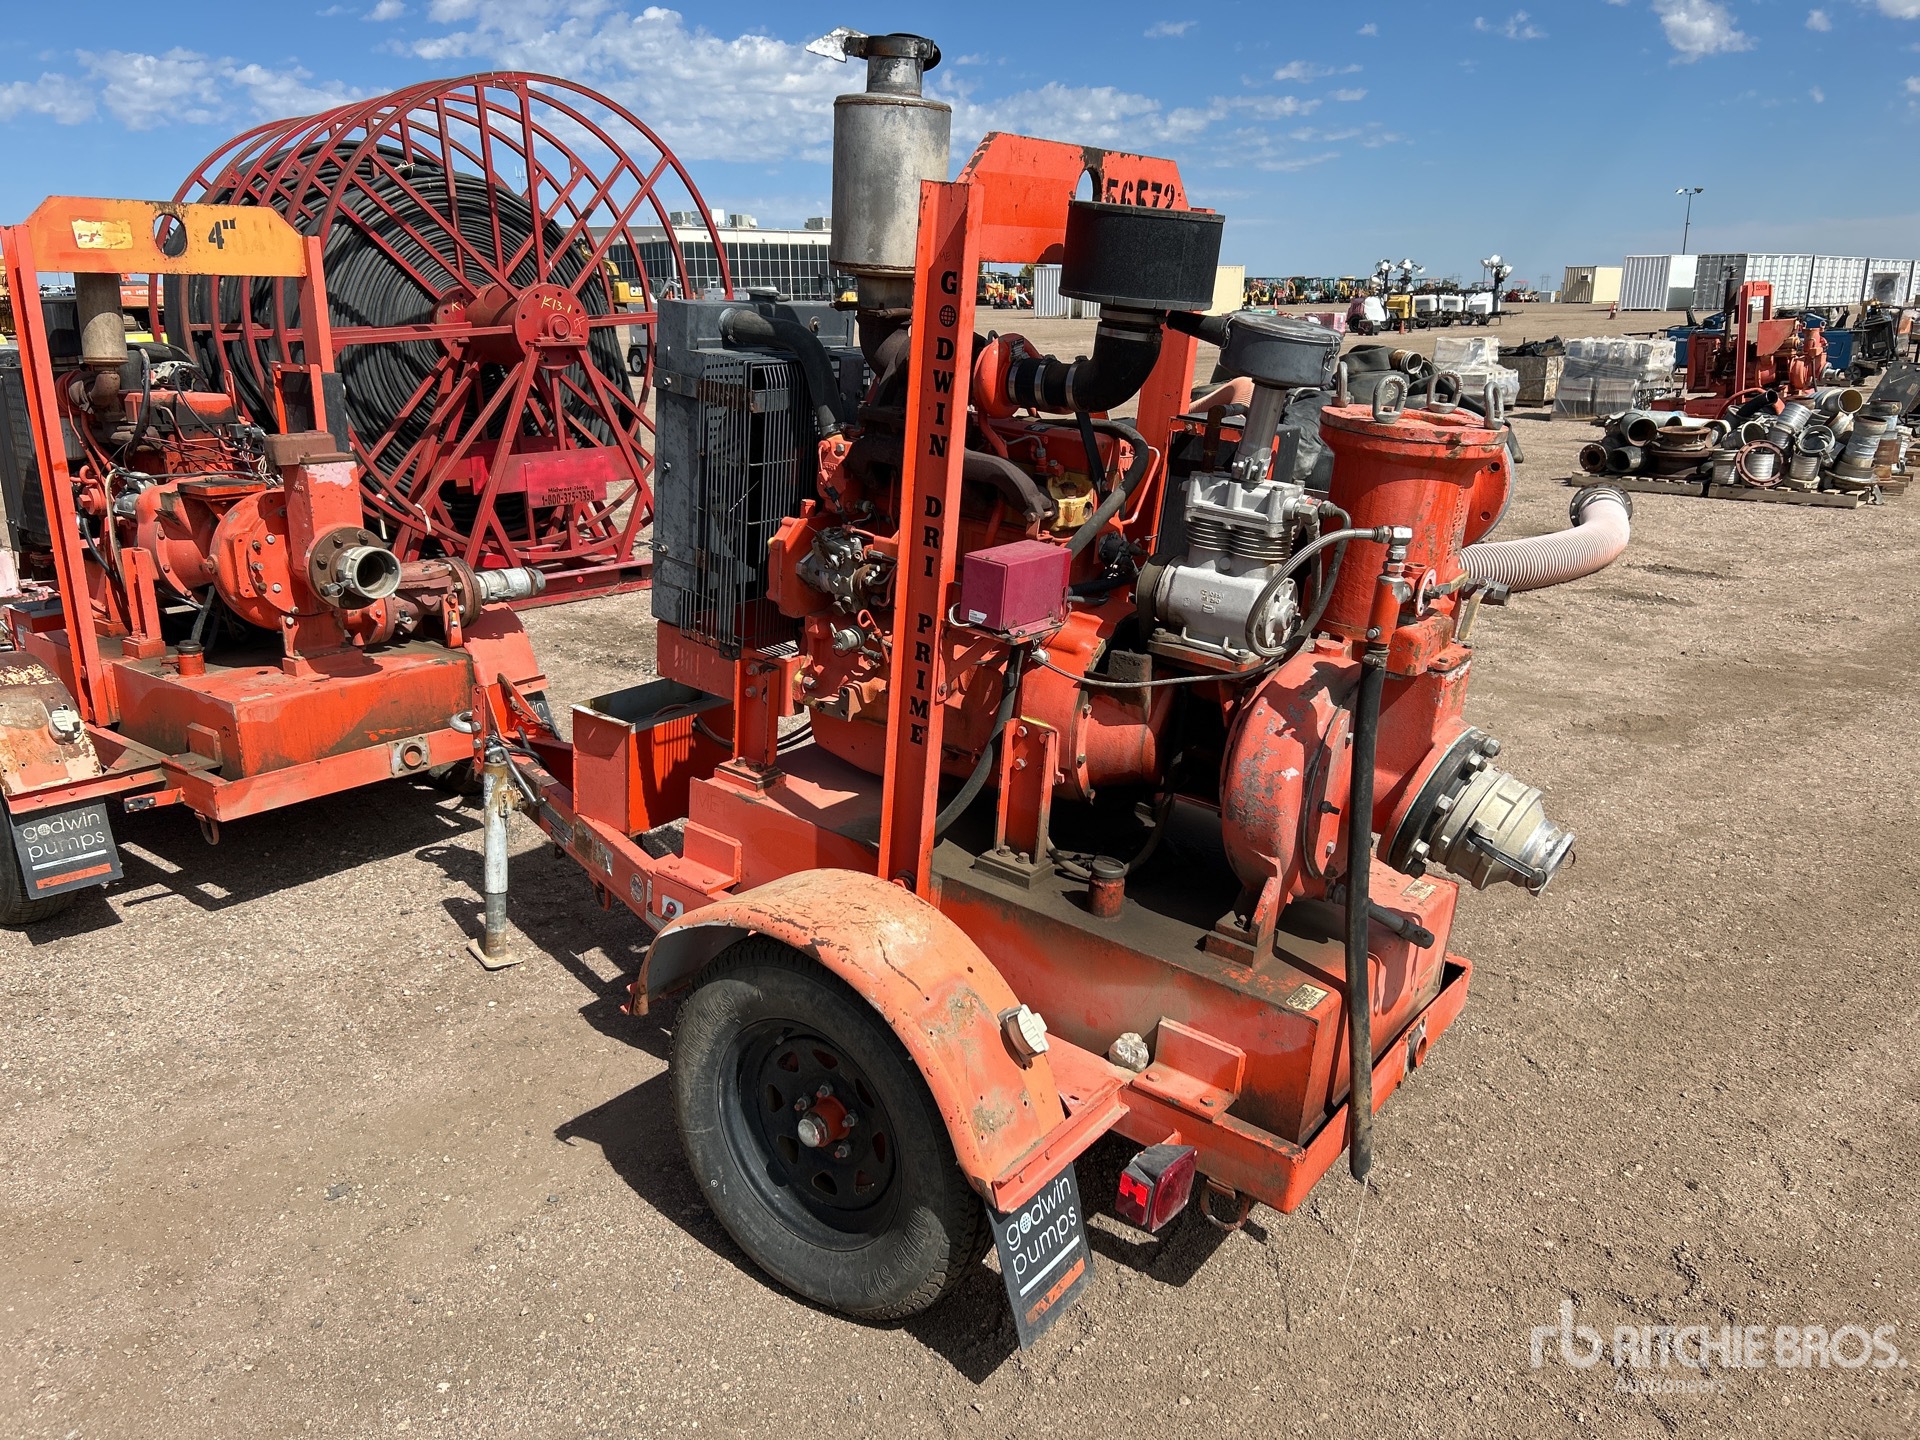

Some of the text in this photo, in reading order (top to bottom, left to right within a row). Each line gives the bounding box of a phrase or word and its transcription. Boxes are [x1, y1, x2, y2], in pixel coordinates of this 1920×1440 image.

[208, 210, 236, 249] 4"
[923, 495, 942, 578] DRI
[909, 612, 933, 745] PRIME
[22, 812, 100, 843] godwin
[27, 831, 105, 862] pumps
[1006, 1177, 1072, 1251] godwin
[1012, 1205, 1078, 1283] pumps
